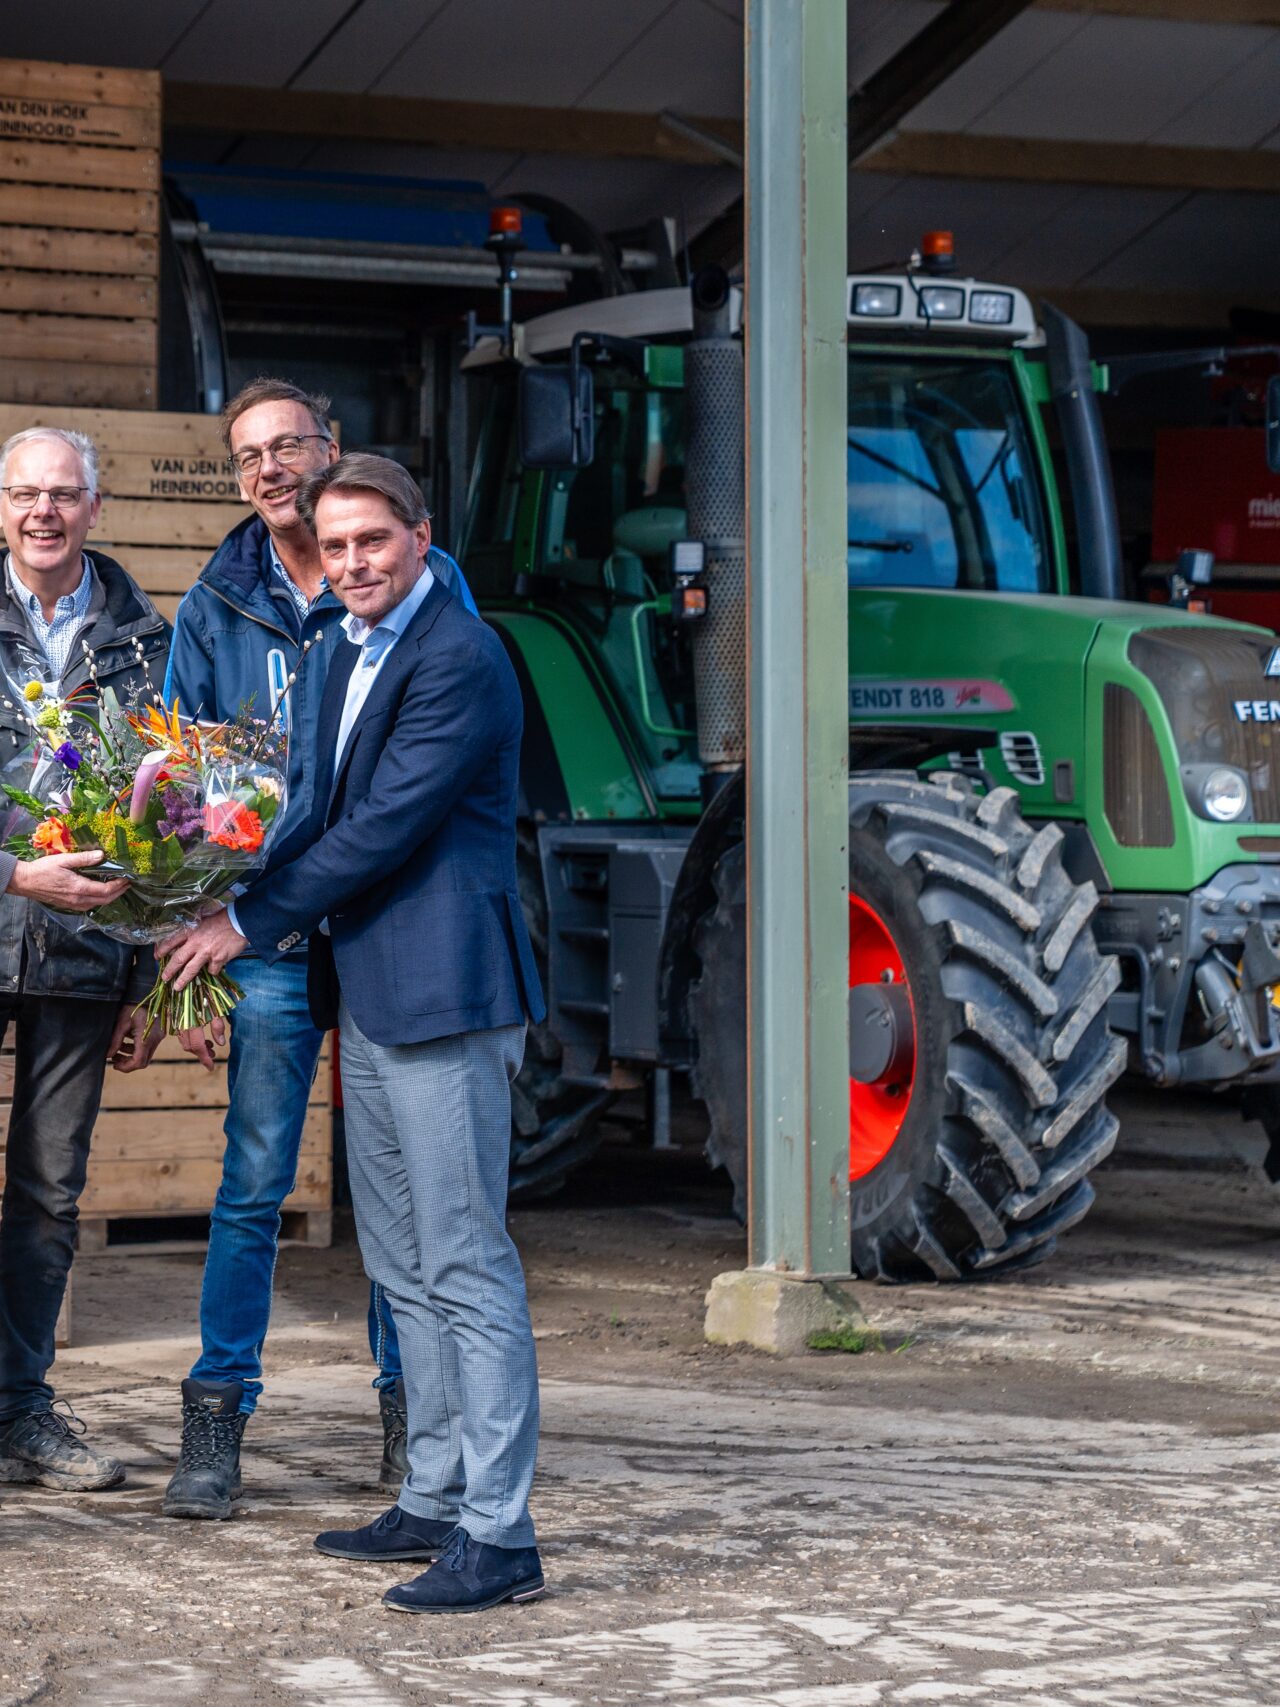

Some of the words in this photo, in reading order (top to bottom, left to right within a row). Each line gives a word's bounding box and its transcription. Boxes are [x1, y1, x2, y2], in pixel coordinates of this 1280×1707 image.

[21, 101, 48, 118] DEN
[51, 104, 89, 121] HOEK
[150, 459, 184, 475] VAN
[189, 460, 217, 475] DEN
[848, 687, 903, 708] ENDT
[910, 687, 945, 709] 818
